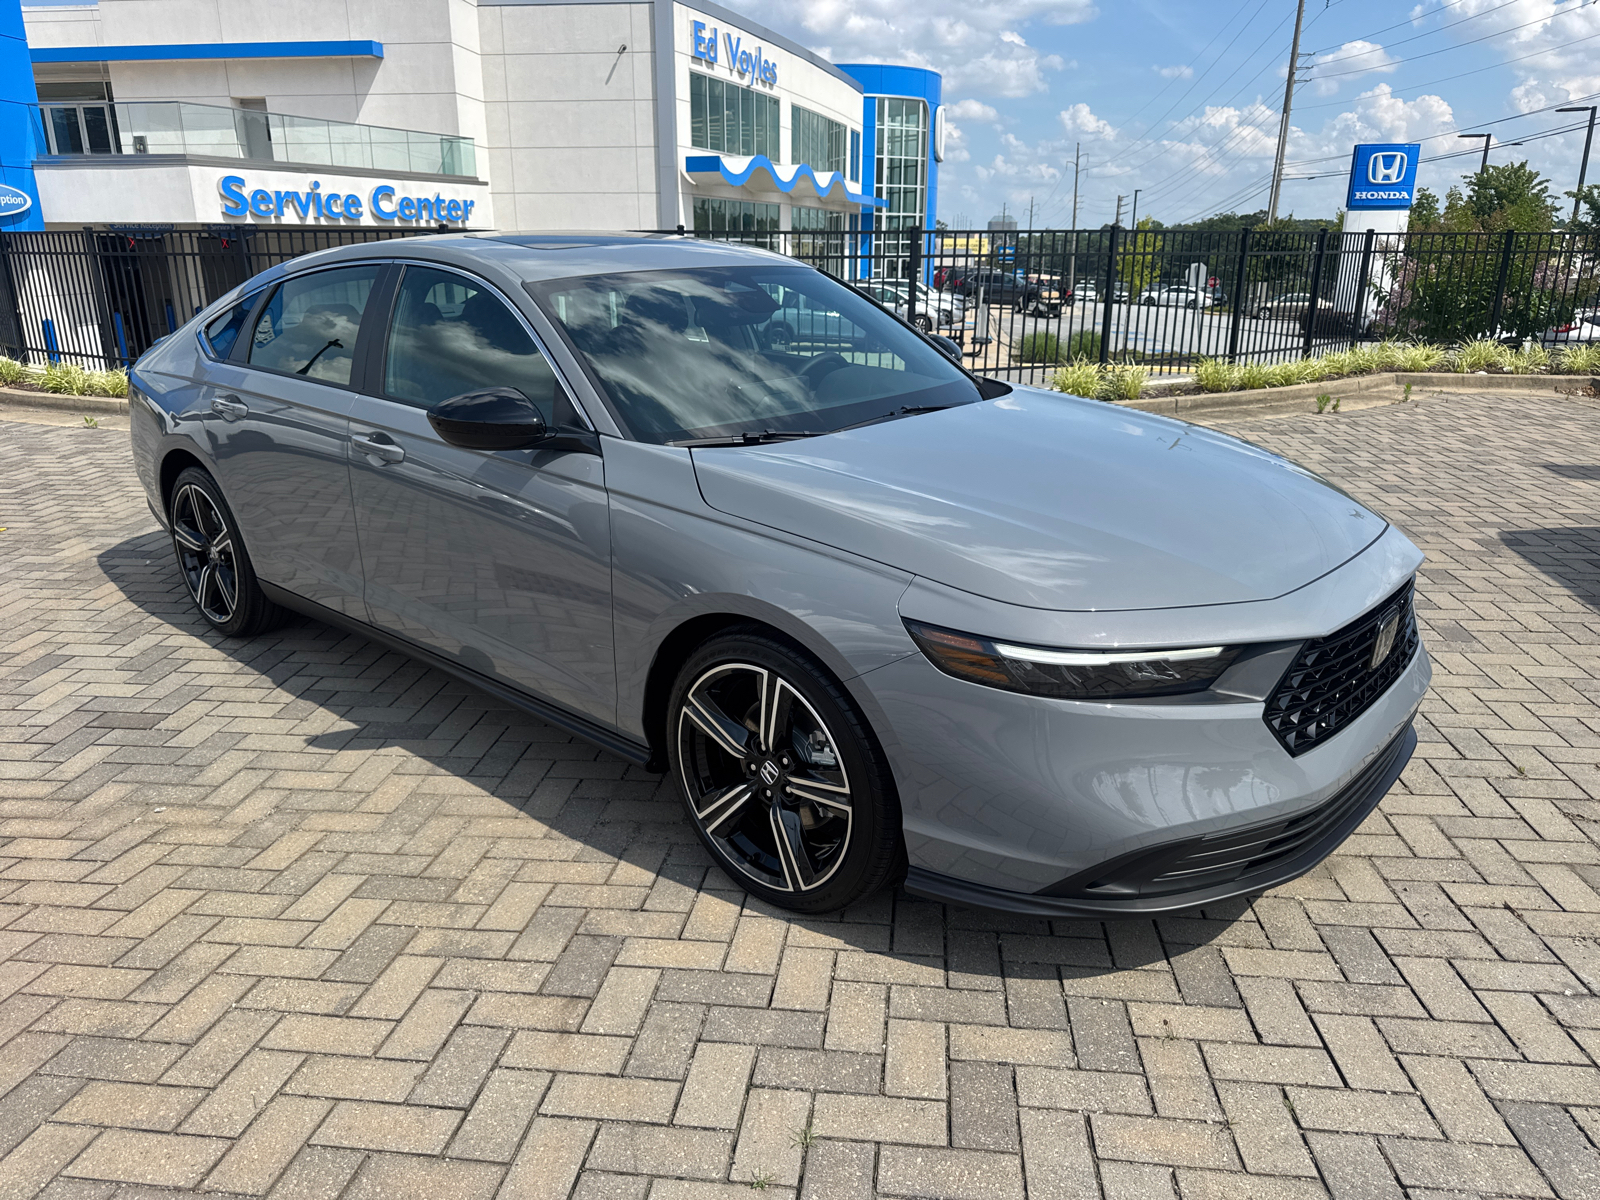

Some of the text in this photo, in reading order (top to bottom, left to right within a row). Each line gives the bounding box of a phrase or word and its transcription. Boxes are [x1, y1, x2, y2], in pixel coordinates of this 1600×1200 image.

[692, 20, 777, 86] Ed Voyles
[219, 175, 475, 221] Service Center
[1354, 191, 1410, 200] HONDA
